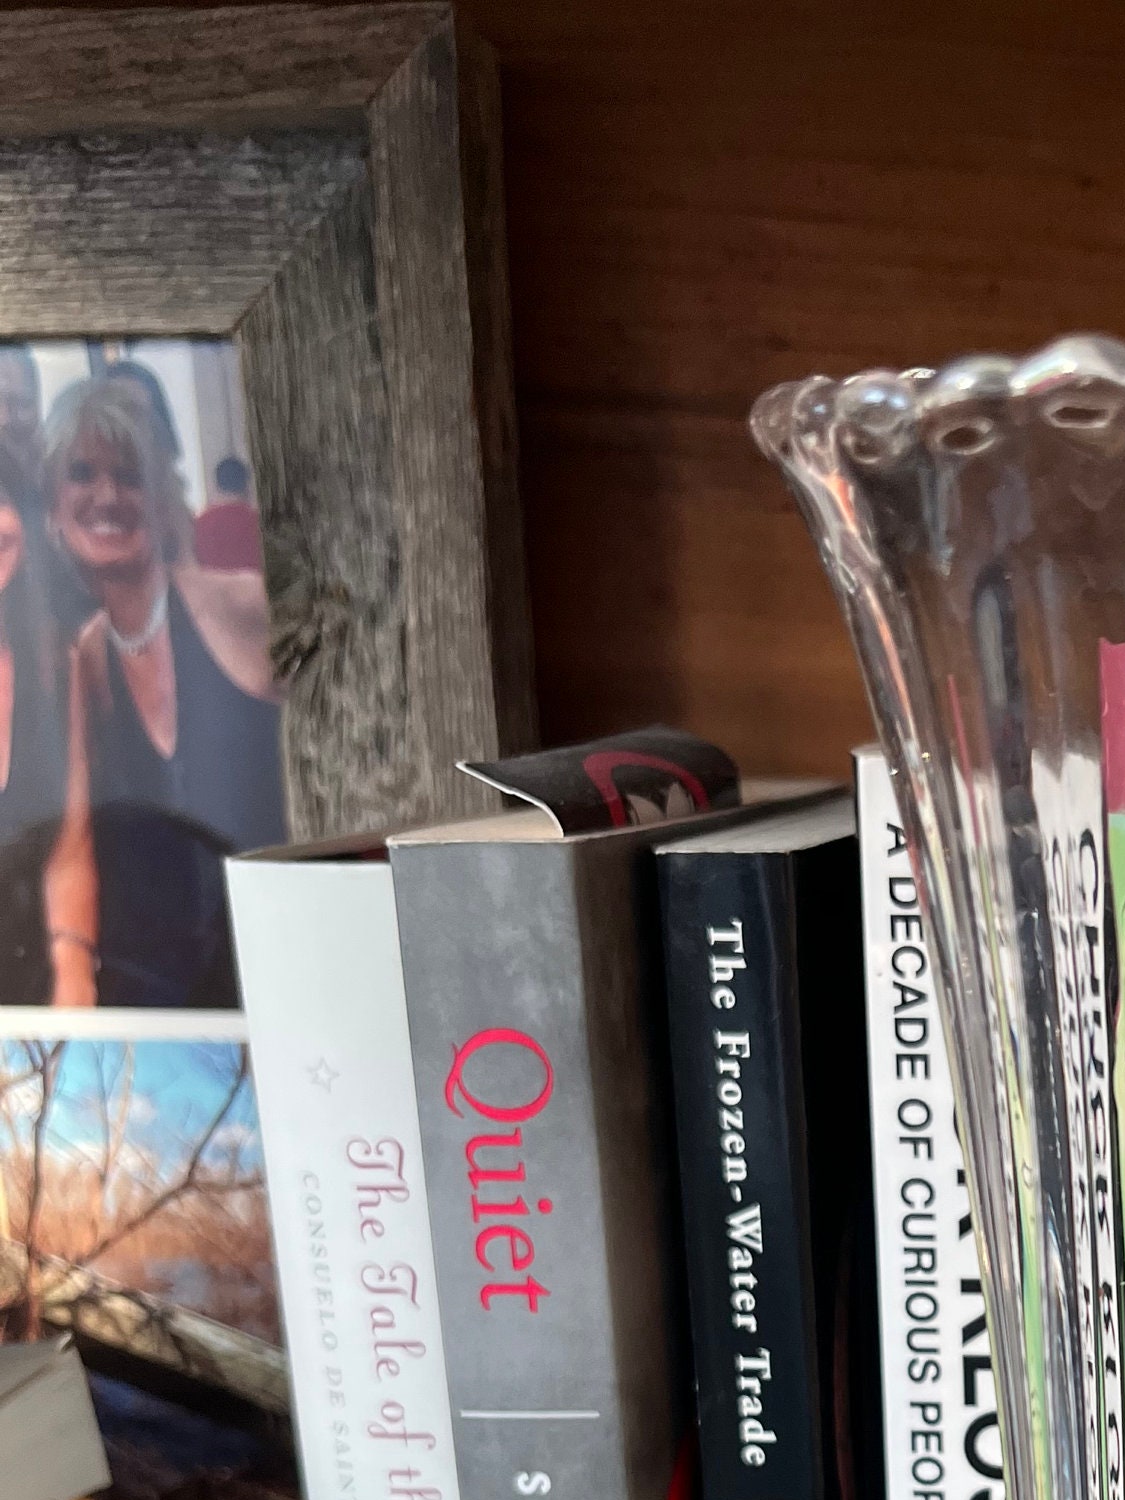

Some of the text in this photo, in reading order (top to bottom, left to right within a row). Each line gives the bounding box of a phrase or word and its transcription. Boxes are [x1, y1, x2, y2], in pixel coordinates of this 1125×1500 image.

[886, 822, 907, 858] A
[888, 876, 931, 1081] DECADE
[346, 1137, 410, 1245] The
[444, 1027, 555, 1314] Quiet
[706, 917, 776, 1469] The Frozen-Water Trade
[898, 1098, 935, 1162] OF
[301, 1170, 339, 1352] CONSUELO
[325, 1366, 346, 1410] DE
[360, 1262, 427, 1382] Tale
[900, 1177, 942, 1385] CURIOUS
[367, 1401, 437, 1450] of
